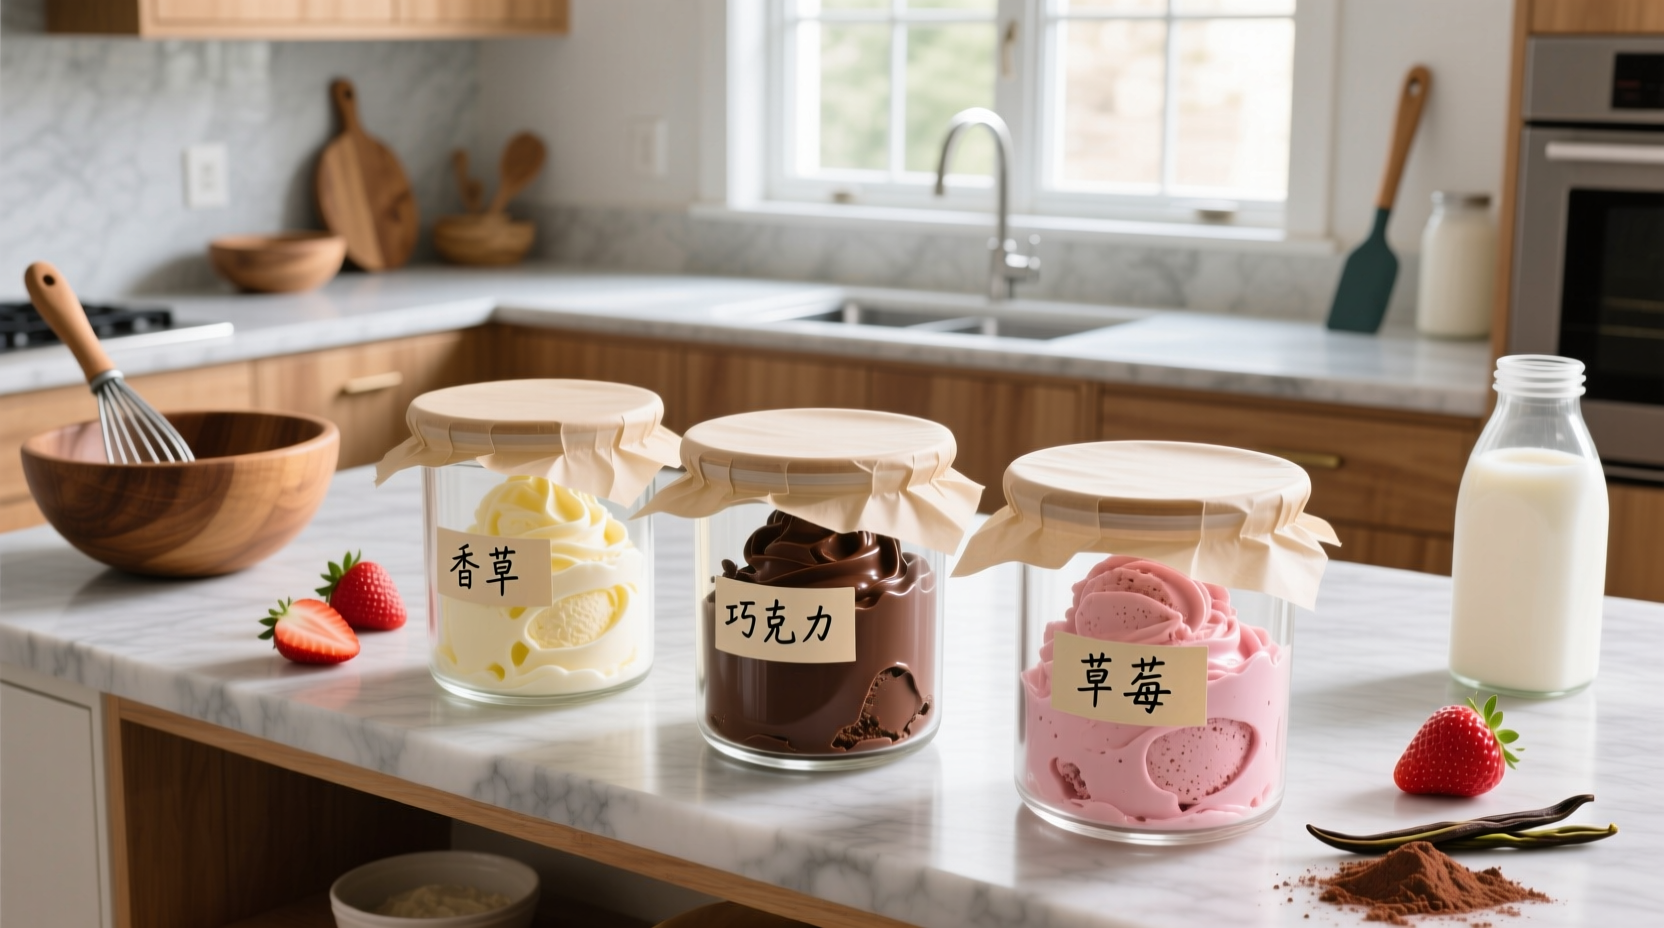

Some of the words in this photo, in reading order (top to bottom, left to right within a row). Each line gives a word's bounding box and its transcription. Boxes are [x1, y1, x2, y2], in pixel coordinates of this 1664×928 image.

[449, 543, 519, 597] 香草
[724, 598, 833, 645] 巧克力
[1077, 652, 1172, 714] 草莓
